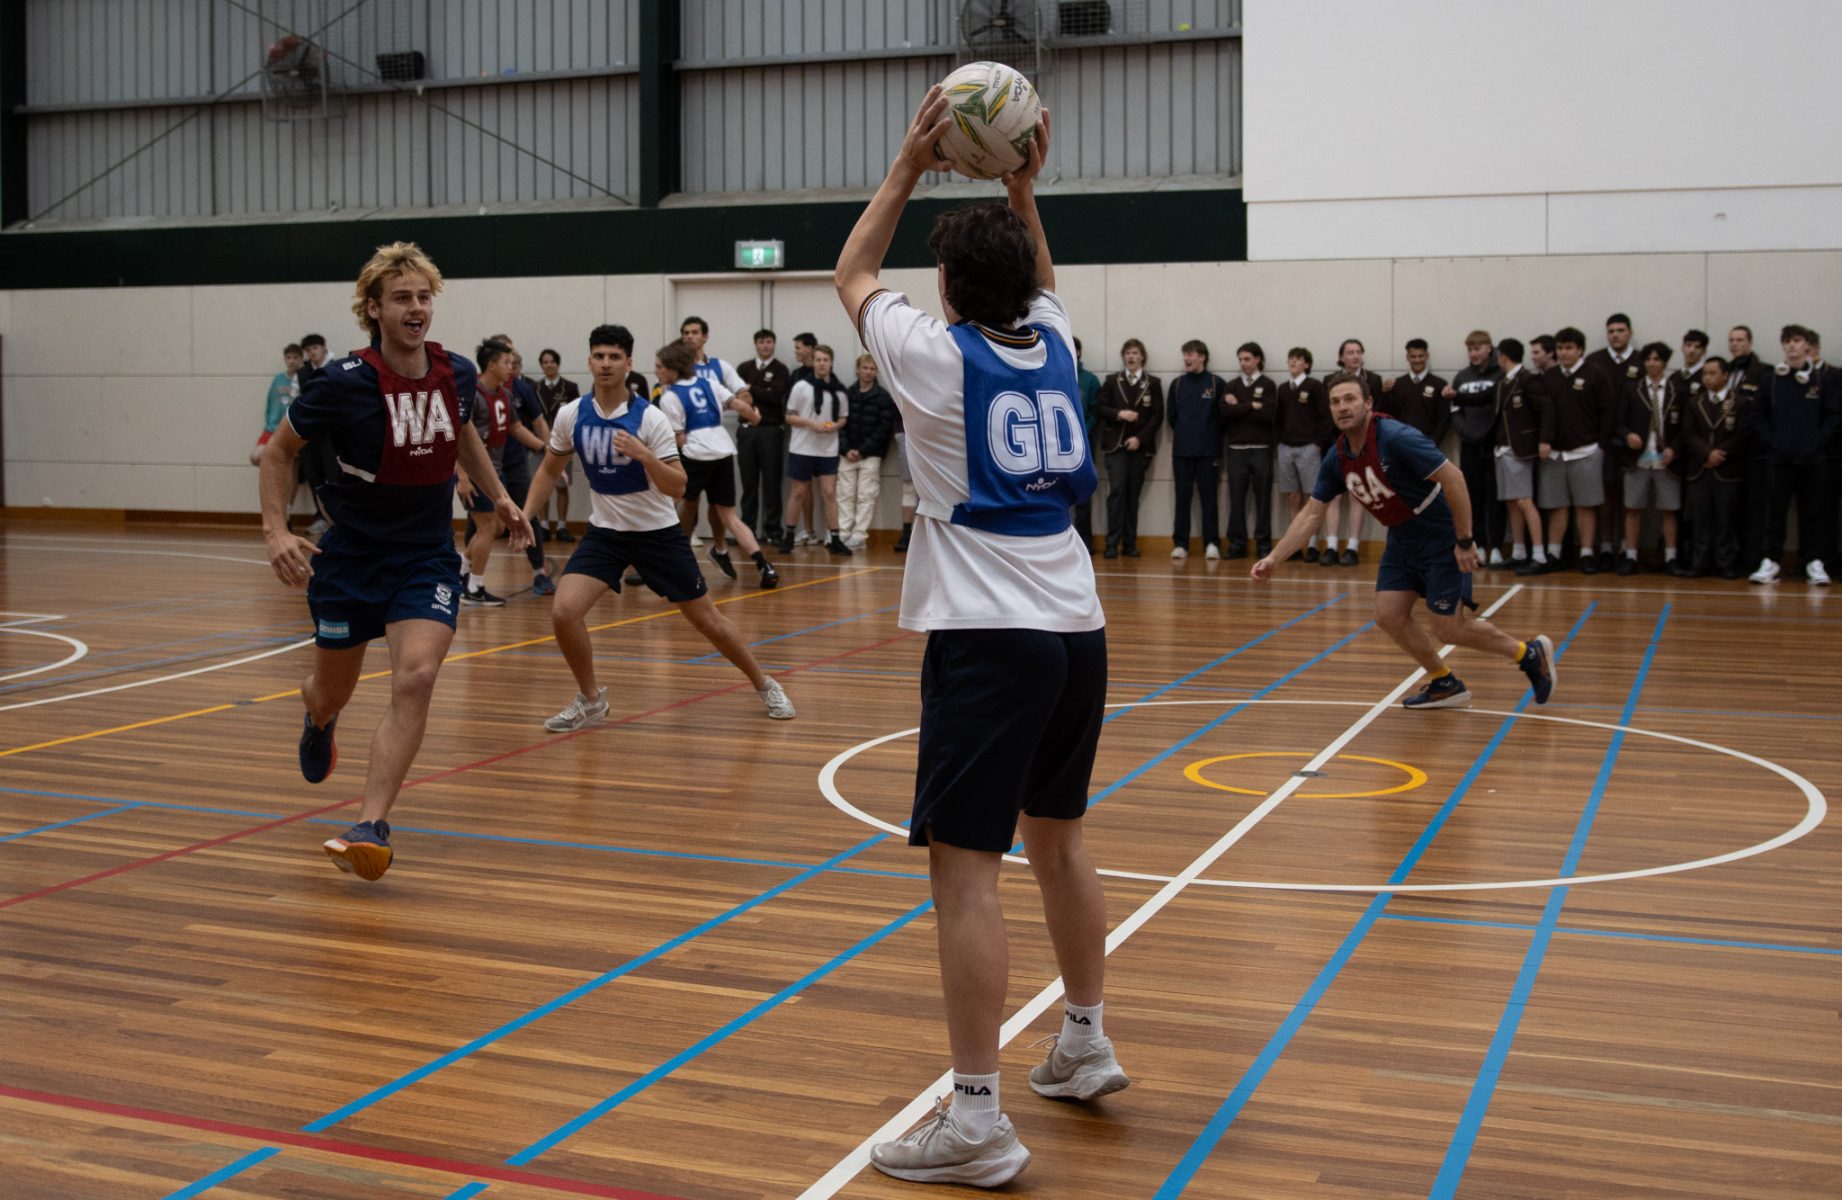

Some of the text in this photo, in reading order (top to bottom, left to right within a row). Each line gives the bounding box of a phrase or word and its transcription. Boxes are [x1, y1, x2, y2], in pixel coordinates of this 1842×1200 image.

[689, 387, 707, 407] C
[385, 389, 455, 447] WA
[987, 390, 1085, 475] GD
[1345, 466, 1395, 504] GA
[954, 1083, 991, 1095] FILA
